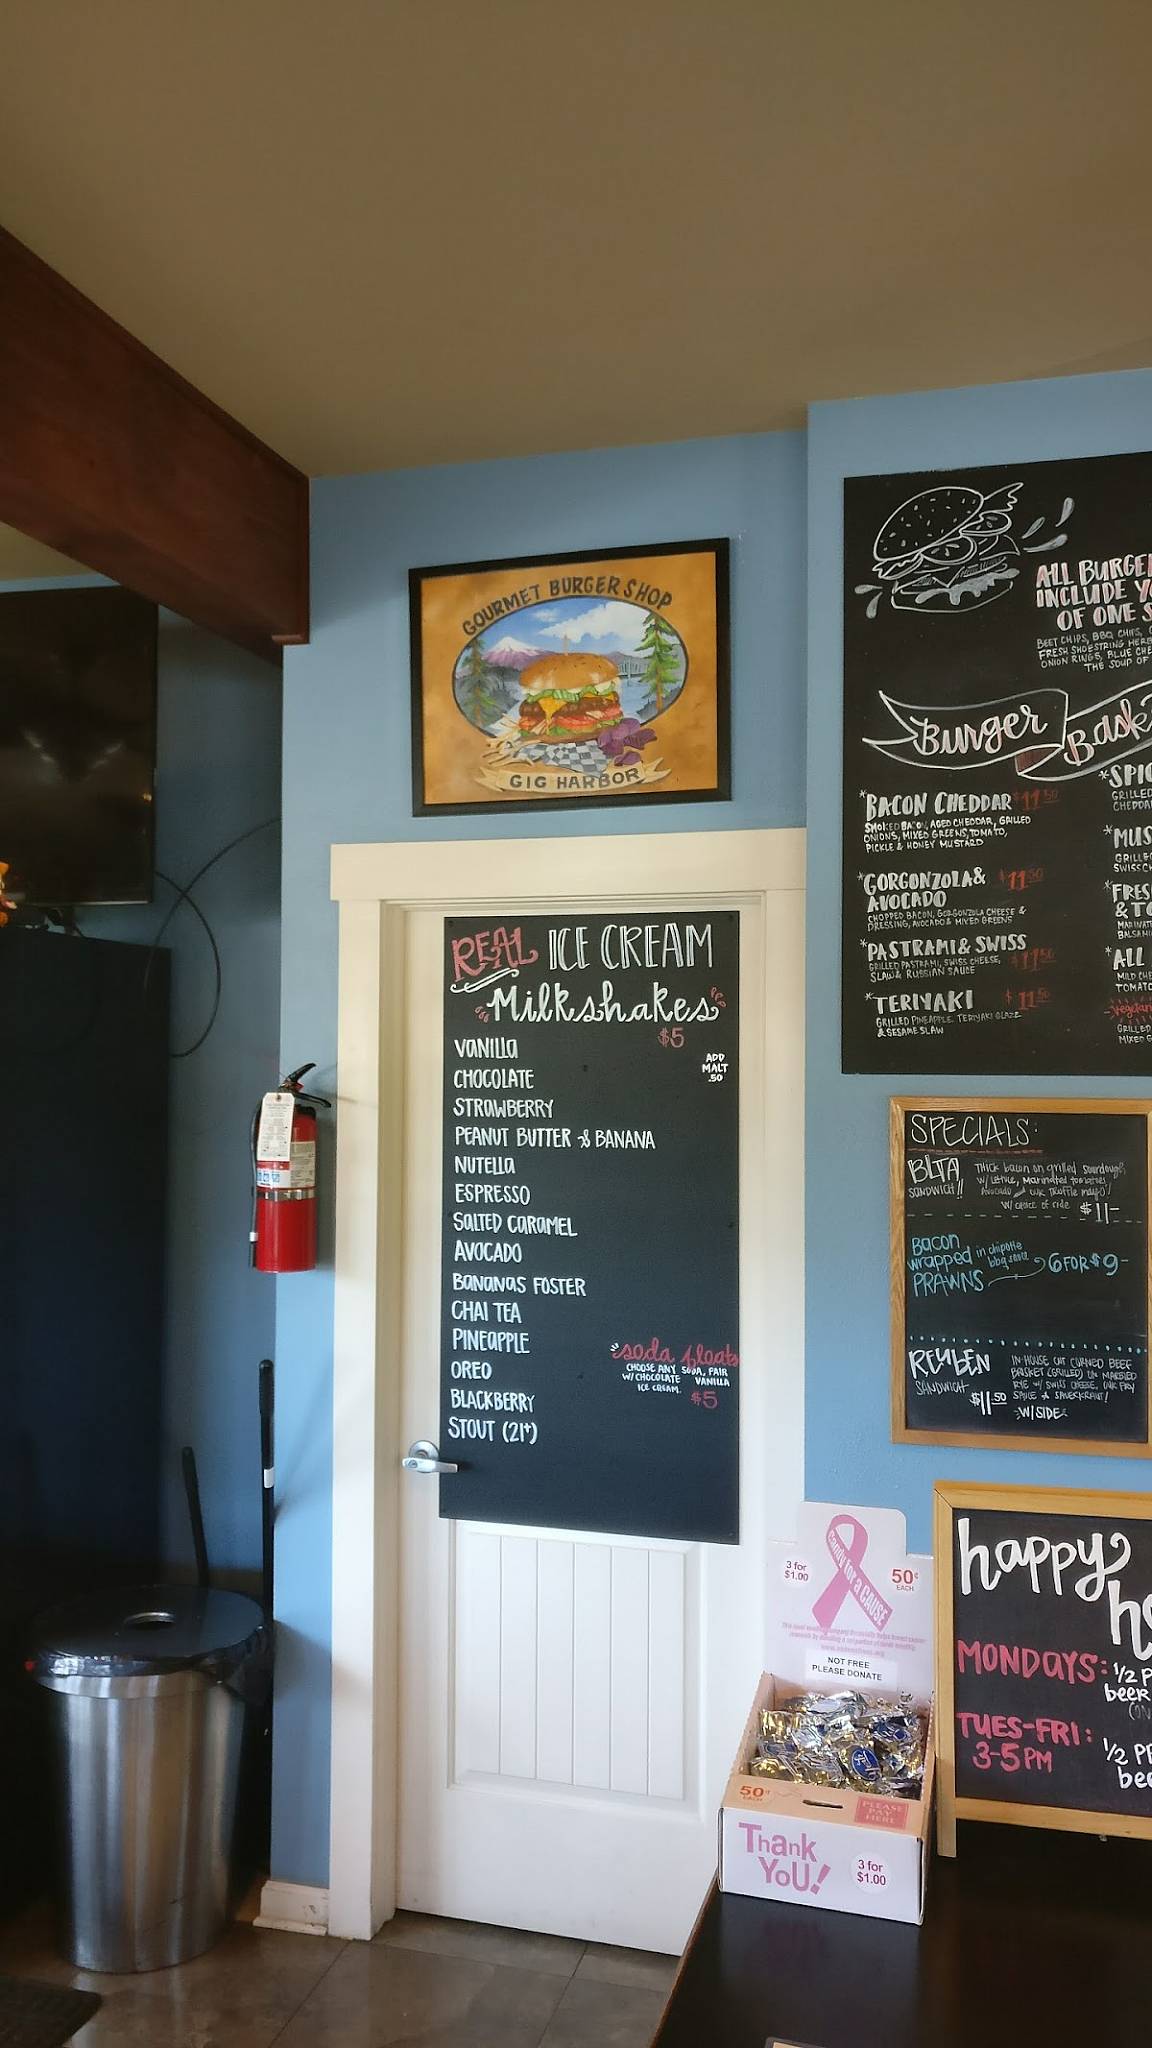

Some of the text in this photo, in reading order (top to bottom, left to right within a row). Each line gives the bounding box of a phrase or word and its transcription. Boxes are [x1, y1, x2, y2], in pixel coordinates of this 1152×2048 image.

[1036, 562, 1075, 588] ALL
[1036, 579, 1127, 608] INCLUDE
[462, 575, 673, 636] GOURMET BURGER SHOP
[1057, 603, 1136, 631] OF ONE
[1037, 638, 1058, 649] BEET
[1093, 631, 1113, 641] BBQ
[1041, 658, 1068, 668] ONION
[1107, 649, 1132, 658] BLUE
[1084, 656, 1149, 672] THE SOUP OF
[909, 704, 1048, 756] Burger
[509, 767, 642, 789] GIG HARBOR
[866, 792, 1012, 821] BACON CHEDDAR
[931, 819, 950, 829] AGED
[999, 816, 1031, 825] GRILLED
[903, 830, 929, 840] MIXED
[866, 843, 894, 853] PICKLE
[907, 840, 935, 850] HONEY
[940, 839, 984, 848] MUSTARD
[867, 890, 947, 913] AVOCADO
[1115, 901, 1128, 919] &
[868, 912, 903, 923] CHOPPED
[986, 907, 1016, 916] CHEESE
[955, 916, 980, 926] MIXED
[981, 915, 1013, 925] GREENS
[451, 922, 712, 982] REAL ICE CREAM
[868, 938, 956, 962] PASTRAMI
[975, 933, 1027, 954] SWISS
[868, 961, 900, 972] GRILLED
[944, 956, 968, 966] SWISS
[1113, 946, 1145, 970] ALL
[906, 967, 945, 979] RUSSIAN
[947, 965, 976, 976] SAUCE
[487, 980, 719, 1022] Milkshakes
[872, 990, 973, 1014] TERIYAKI
[876, 1015, 909, 1028] GRILLED
[886, 1027, 918, 1036] SESAME
[920, 1025, 944, 1035] SLAW
[658, 1026, 685, 1048] $5
[702, 1063, 728, 1073] MALT
[705, 1053, 725, 1063] ADD
[453, 1069, 535, 1089] CHOCOLATE
[708, 1073, 724, 1082] .50
[453, 1098, 553, 1118] STRAWBERRY
[455, 1126, 509, 1147] PEANUT
[516, 1128, 571, 1148] BUTTER
[595, 1130, 656, 1149] BANANA
[911, 1113, 1038, 1147] SPECIALS:
[907, 1155, 960, 1184] BLTA
[455, 1184, 530, 1205] ESPRESSO
[453, 1212, 502, 1233] SALTED
[454, 1240, 522, 1263] AVOCADO
[911, 1234, 960, 1256] Bacon
[907, 1249, 973, 1273] wrapped
[976, 1247, 987, 1259] in
[987, 1255, 1010, 1271] bbq
[533, 1277, 586, 1296] FOSTER
[913, 1269, 984, 1297] PRAWNS
[451, 1301, 522, 1324] CHAI TEA
[452, 1328, 530, 1354] PINEAPPLE
[612, 1337, 675, 1363] soda
[451, 1361, 492, 1380] OREO
[626, 1363, 656, 1373] CHOOSE
[658, 1364, 676, 1375] ANY
[708, 1367, 728, 1377] PAIR
[1109, 1358, 1132, 1370] BEEF
[637, 1383, 650, 1392] ICE
[695, 1377, 730, 1387] VANILLA
[915, 1379, 970, 1397] SANDWICH
[451, 1389, 535, 1413] BLACKBERRY
[690, 1390, 718, 1409] $5
[448, 1416, 495, 1442] STOUT
[786, 1561, 792, 1569] 3
[794, 1562, 808, 1571] for
[958, 1516, 1132, 1602] happy
[784, 1570, 809, 1581] $1.00
[827, 1657, 870, 1669] NOT FREE
[957, 1639, 1108, 1685] MONDAYS:
[812, 1664, 883, 1681] PLEASE DONATE
[739, 1822, 817, 1862] Thank
[858, 1860, 883, 1872] 3 for
[857, 1872, 887, 1886] $1.00
